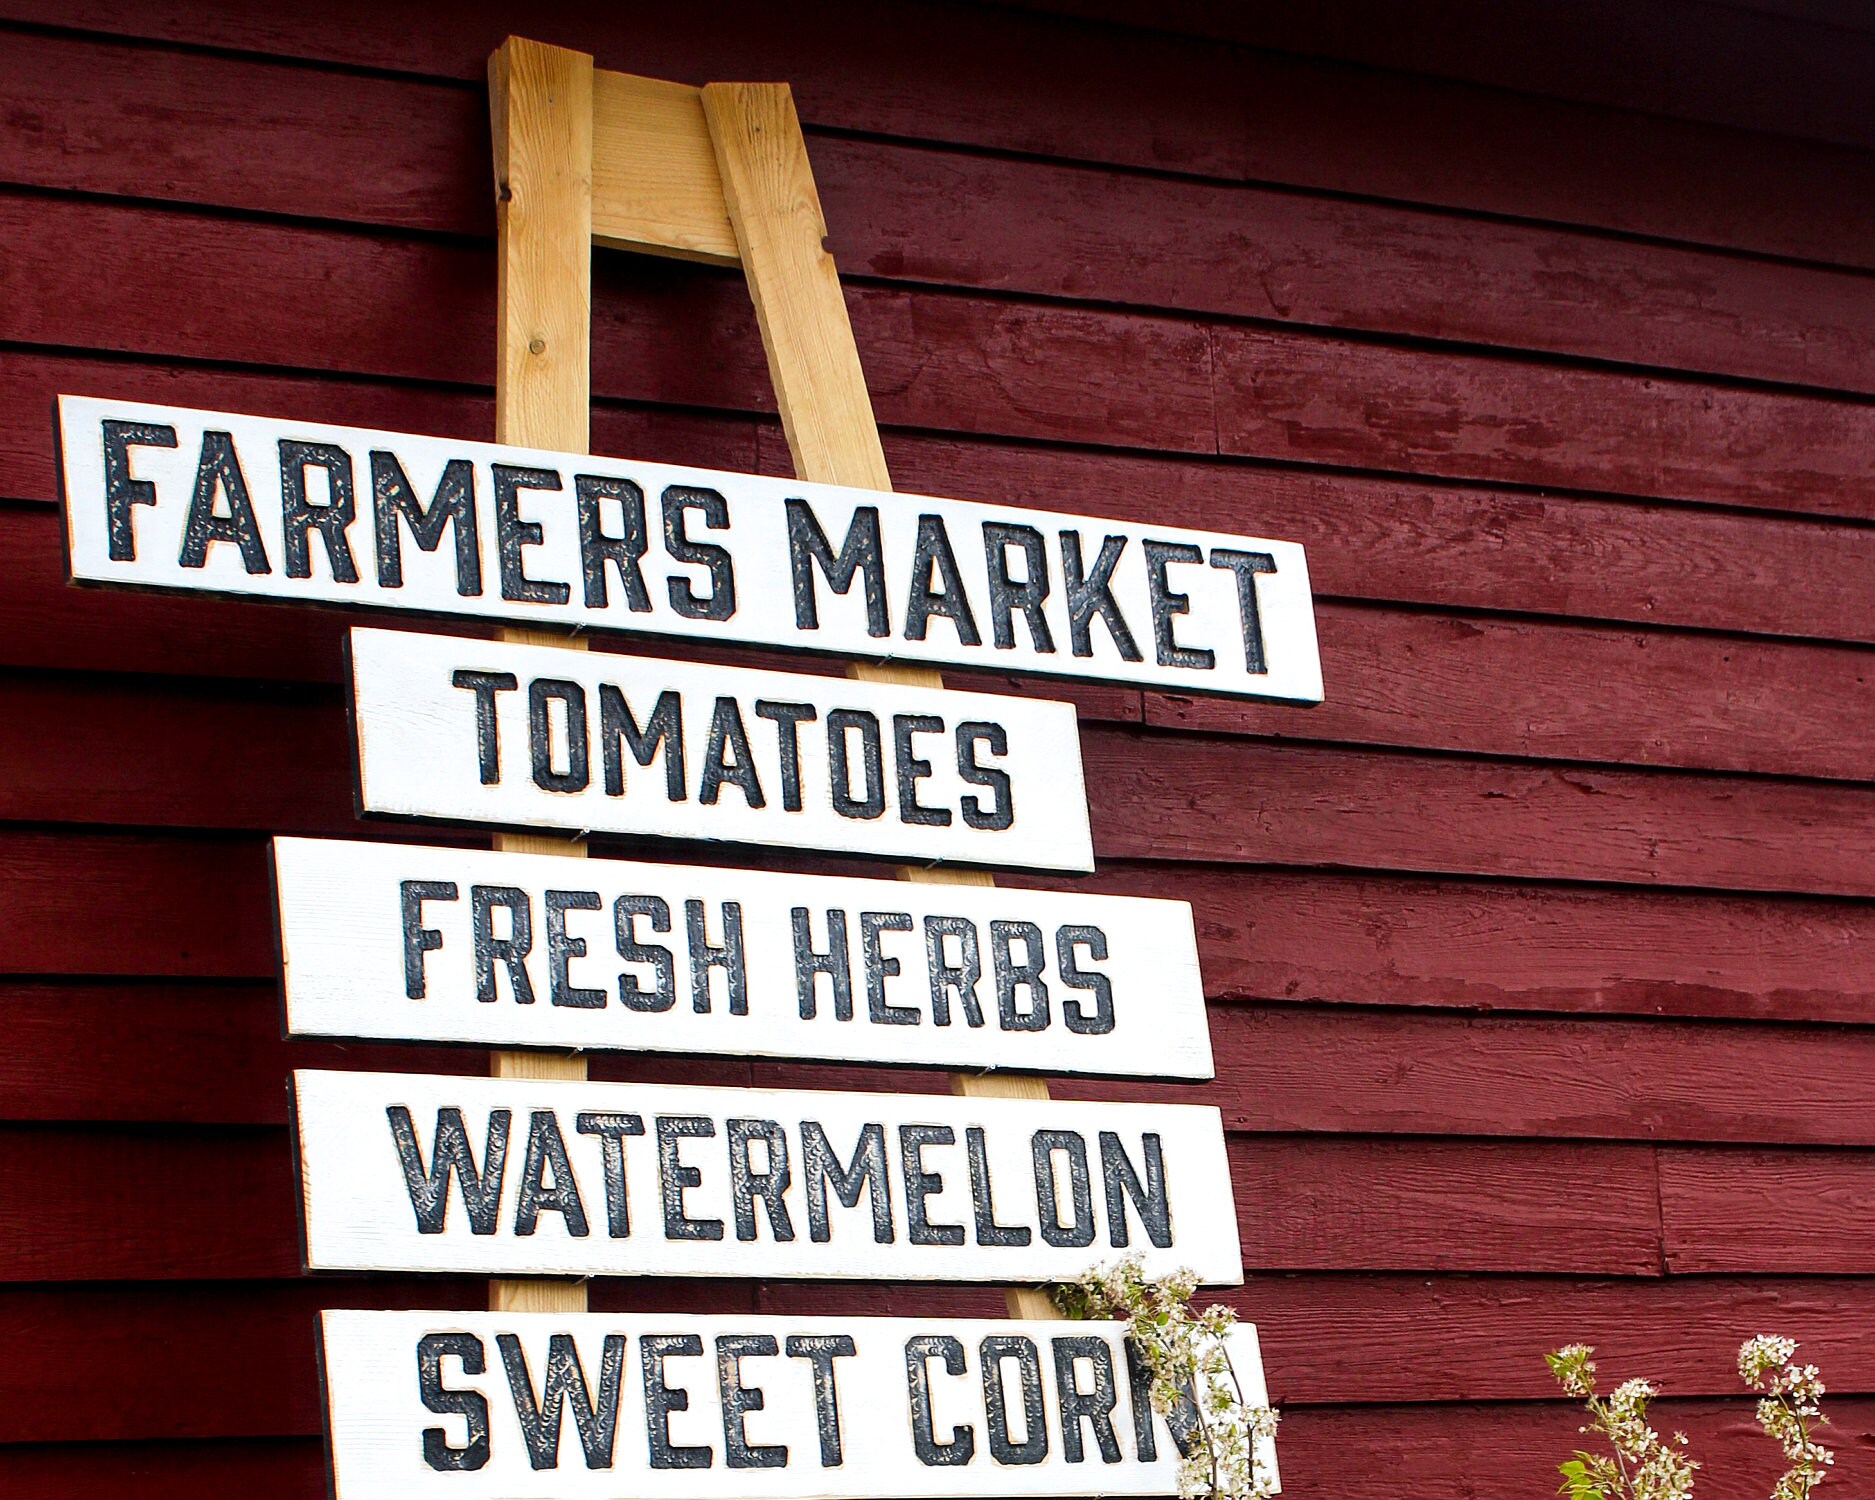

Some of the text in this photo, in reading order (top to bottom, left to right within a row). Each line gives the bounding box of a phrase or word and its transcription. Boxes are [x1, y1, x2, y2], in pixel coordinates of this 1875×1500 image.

[102, 417, 1278, 676] FARMERS MARKET
[452, 668, 1013, 832] TOMATOES
[400, 879, 1115, 1036] FRESH HERBS
[386, 1105, 1173, 1249] WATERMELON
[417, 1332, 857, 1472] SWEET
